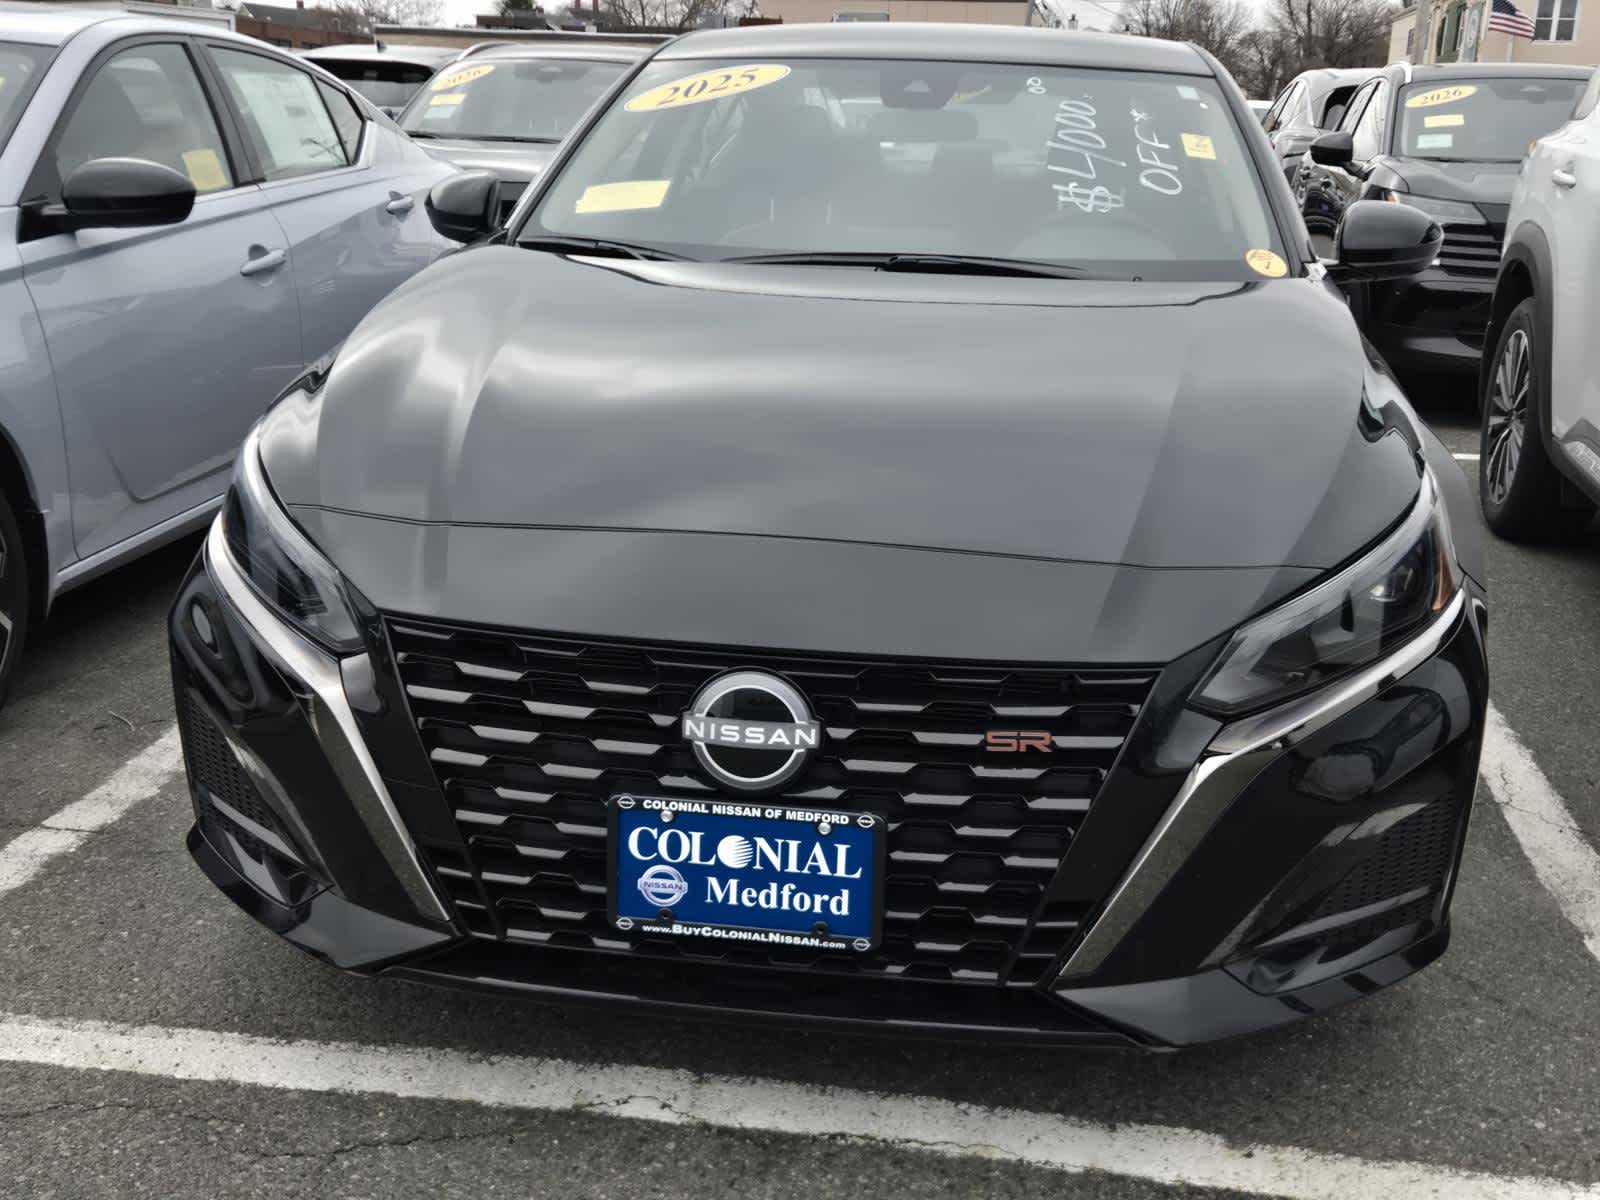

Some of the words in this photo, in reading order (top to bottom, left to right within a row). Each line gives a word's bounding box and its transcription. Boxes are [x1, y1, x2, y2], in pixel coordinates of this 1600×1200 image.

[656, 68, 759, 105] 2025
[684, 718, 817, 746] NISSAN
[985, 730, 1053, 753] SR
[642, 799, 709, 814] COLONIAL
[712, 804, 762, 818] NISSAN
[764, 808, 783, 819] OF
[785, 810, 849, 825] MEDFORD
[627, 825, 863, 879] COLONIAL
[643, 880, 684, 892] NISSAN
[704, 876, 850, 916] Medford
